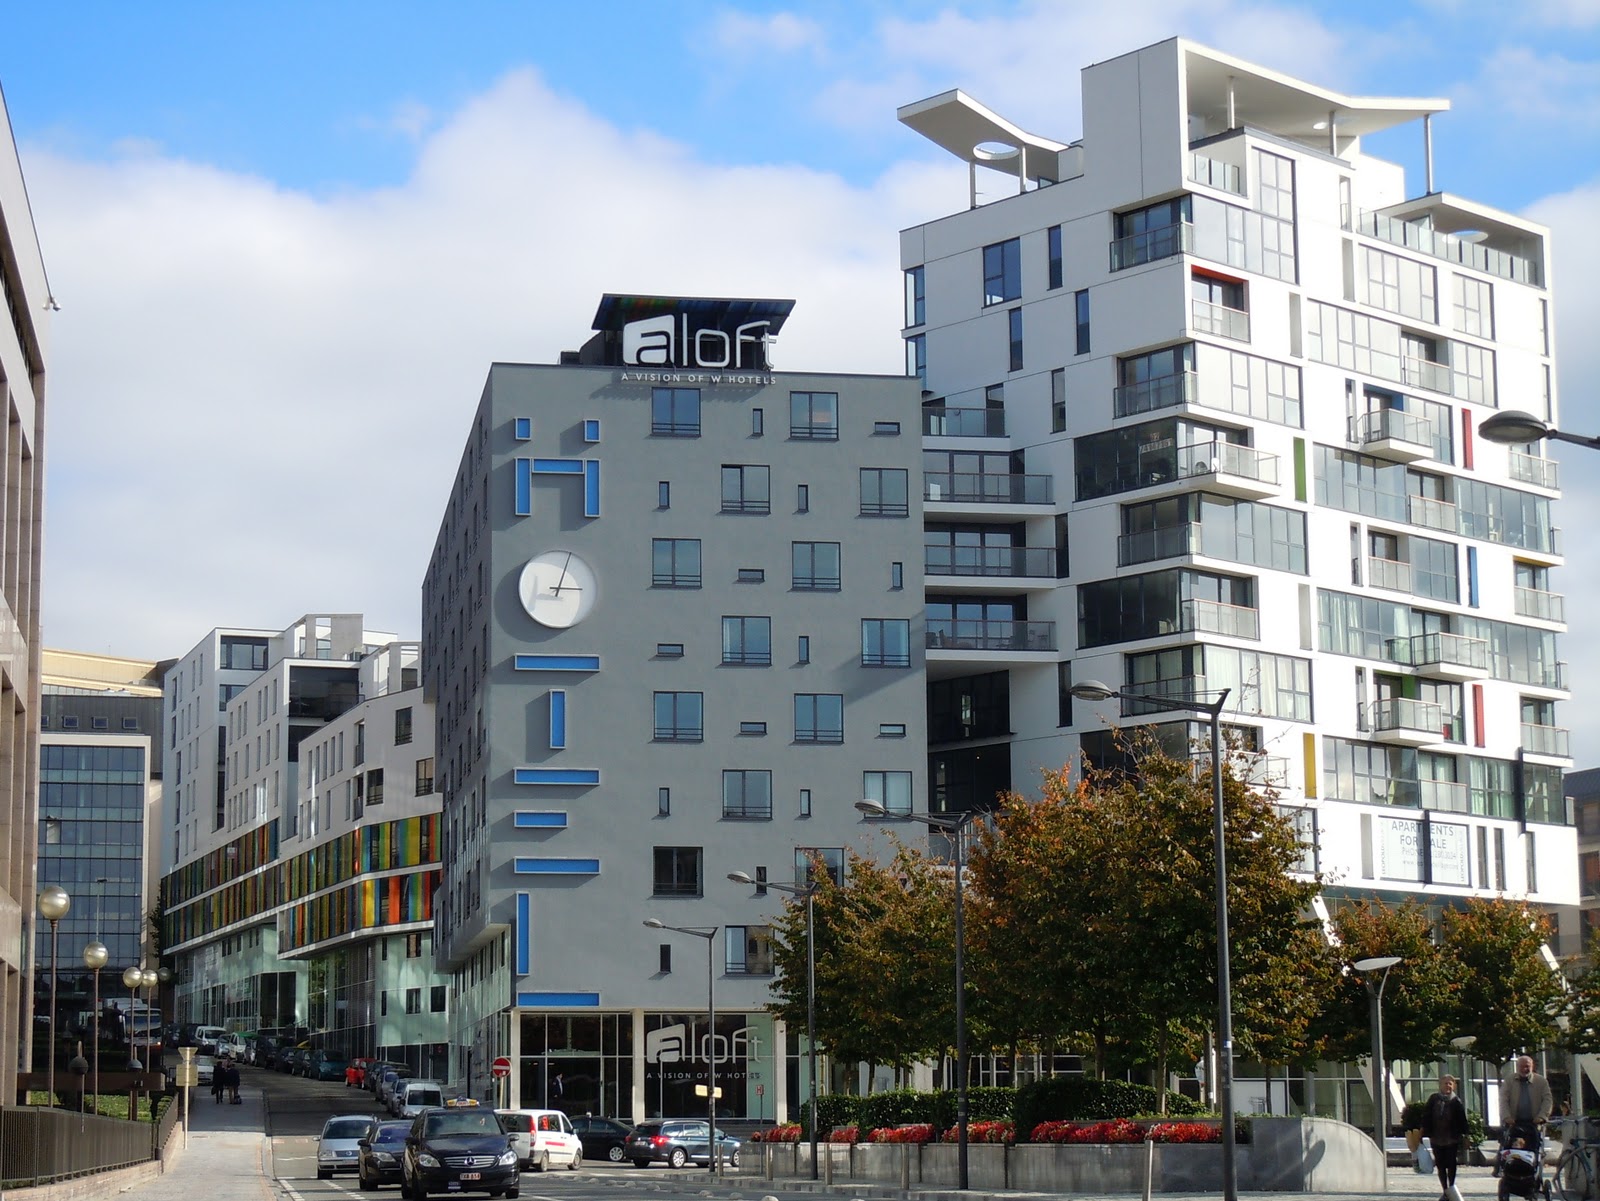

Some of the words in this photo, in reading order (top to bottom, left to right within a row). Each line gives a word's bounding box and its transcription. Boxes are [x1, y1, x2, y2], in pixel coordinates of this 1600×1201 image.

[623, 312, 777, 370] aloft
[621, 372, 629, 381] A
[635, 373, 680, 382] VISION
[687, 374, 704, 383] OF
[710, 375, 721, 383] W
[728, 375, 776, 385] HOTELS
[1391, 820, 1455, 836] APARTENTS
[646, 1022, 763, 1064] aloft
